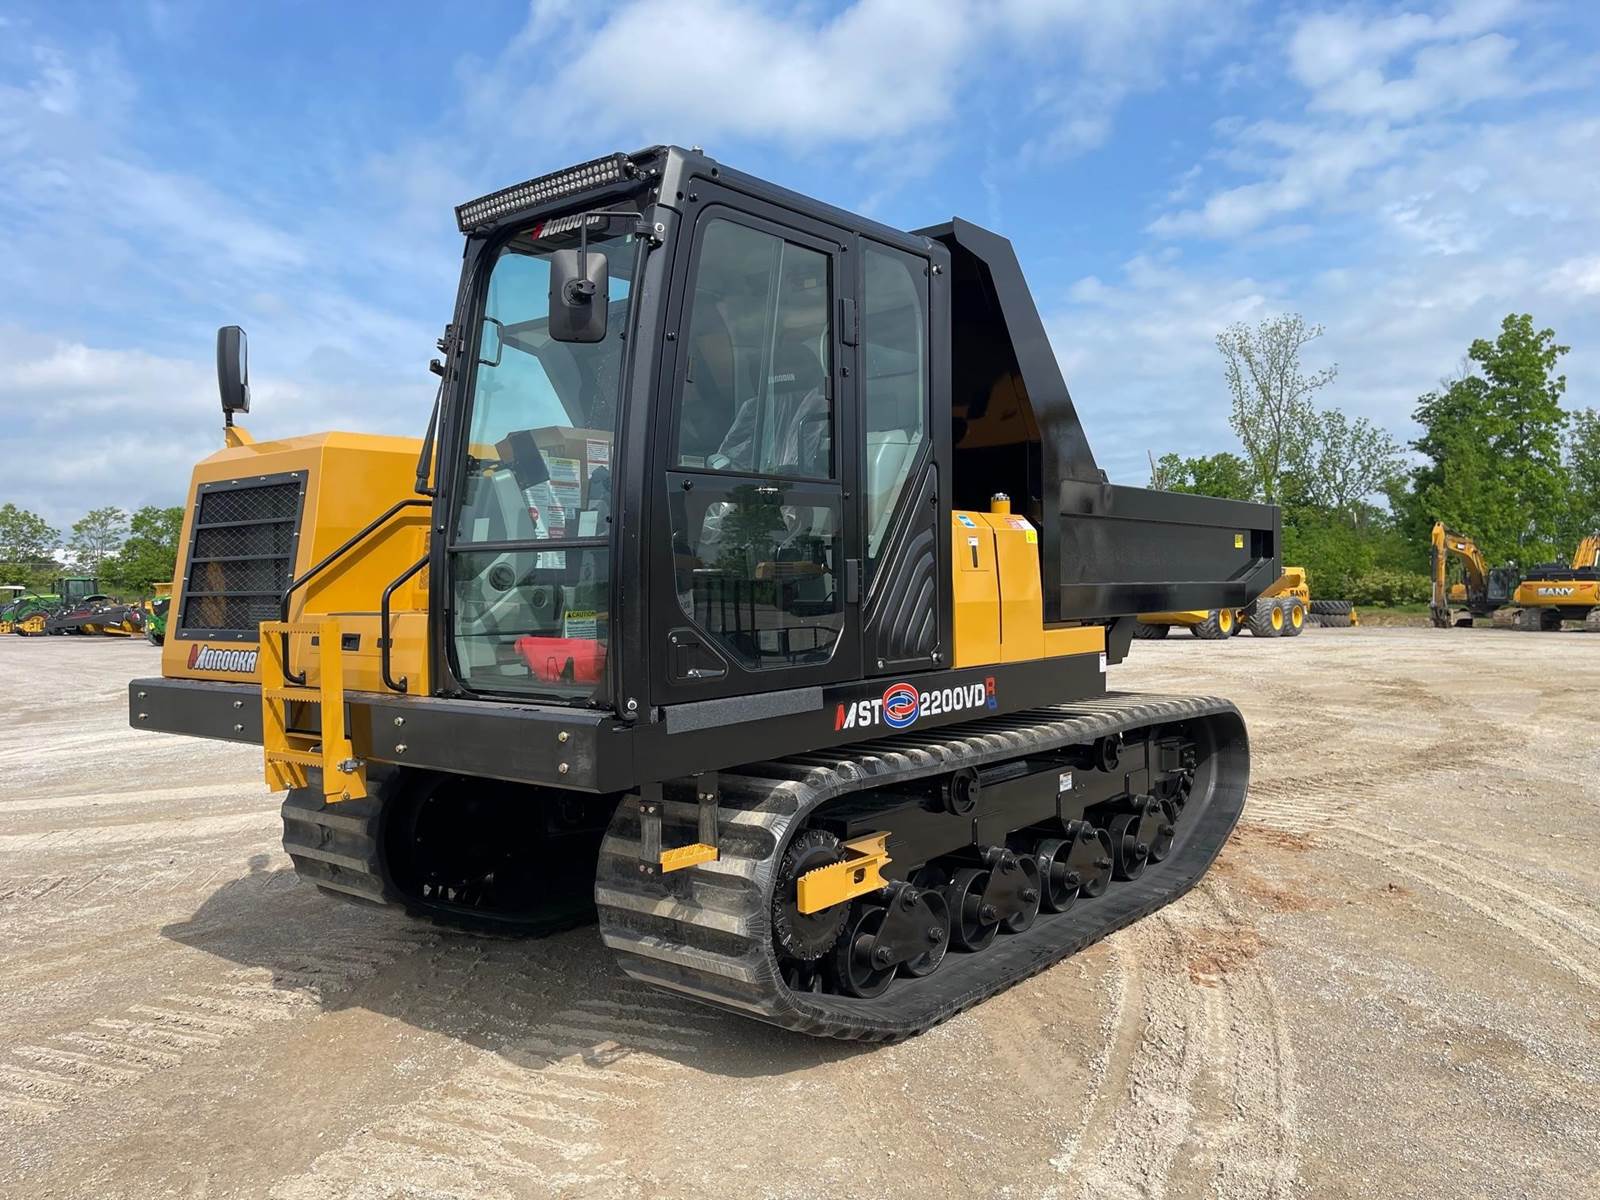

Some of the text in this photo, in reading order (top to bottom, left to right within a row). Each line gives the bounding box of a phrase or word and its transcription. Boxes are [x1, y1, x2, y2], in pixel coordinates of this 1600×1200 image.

[1537, 587, 1575, 596] SANY
[187, 643, 258, 673] MOROOKA
[834, 699, 883, 731] MST
